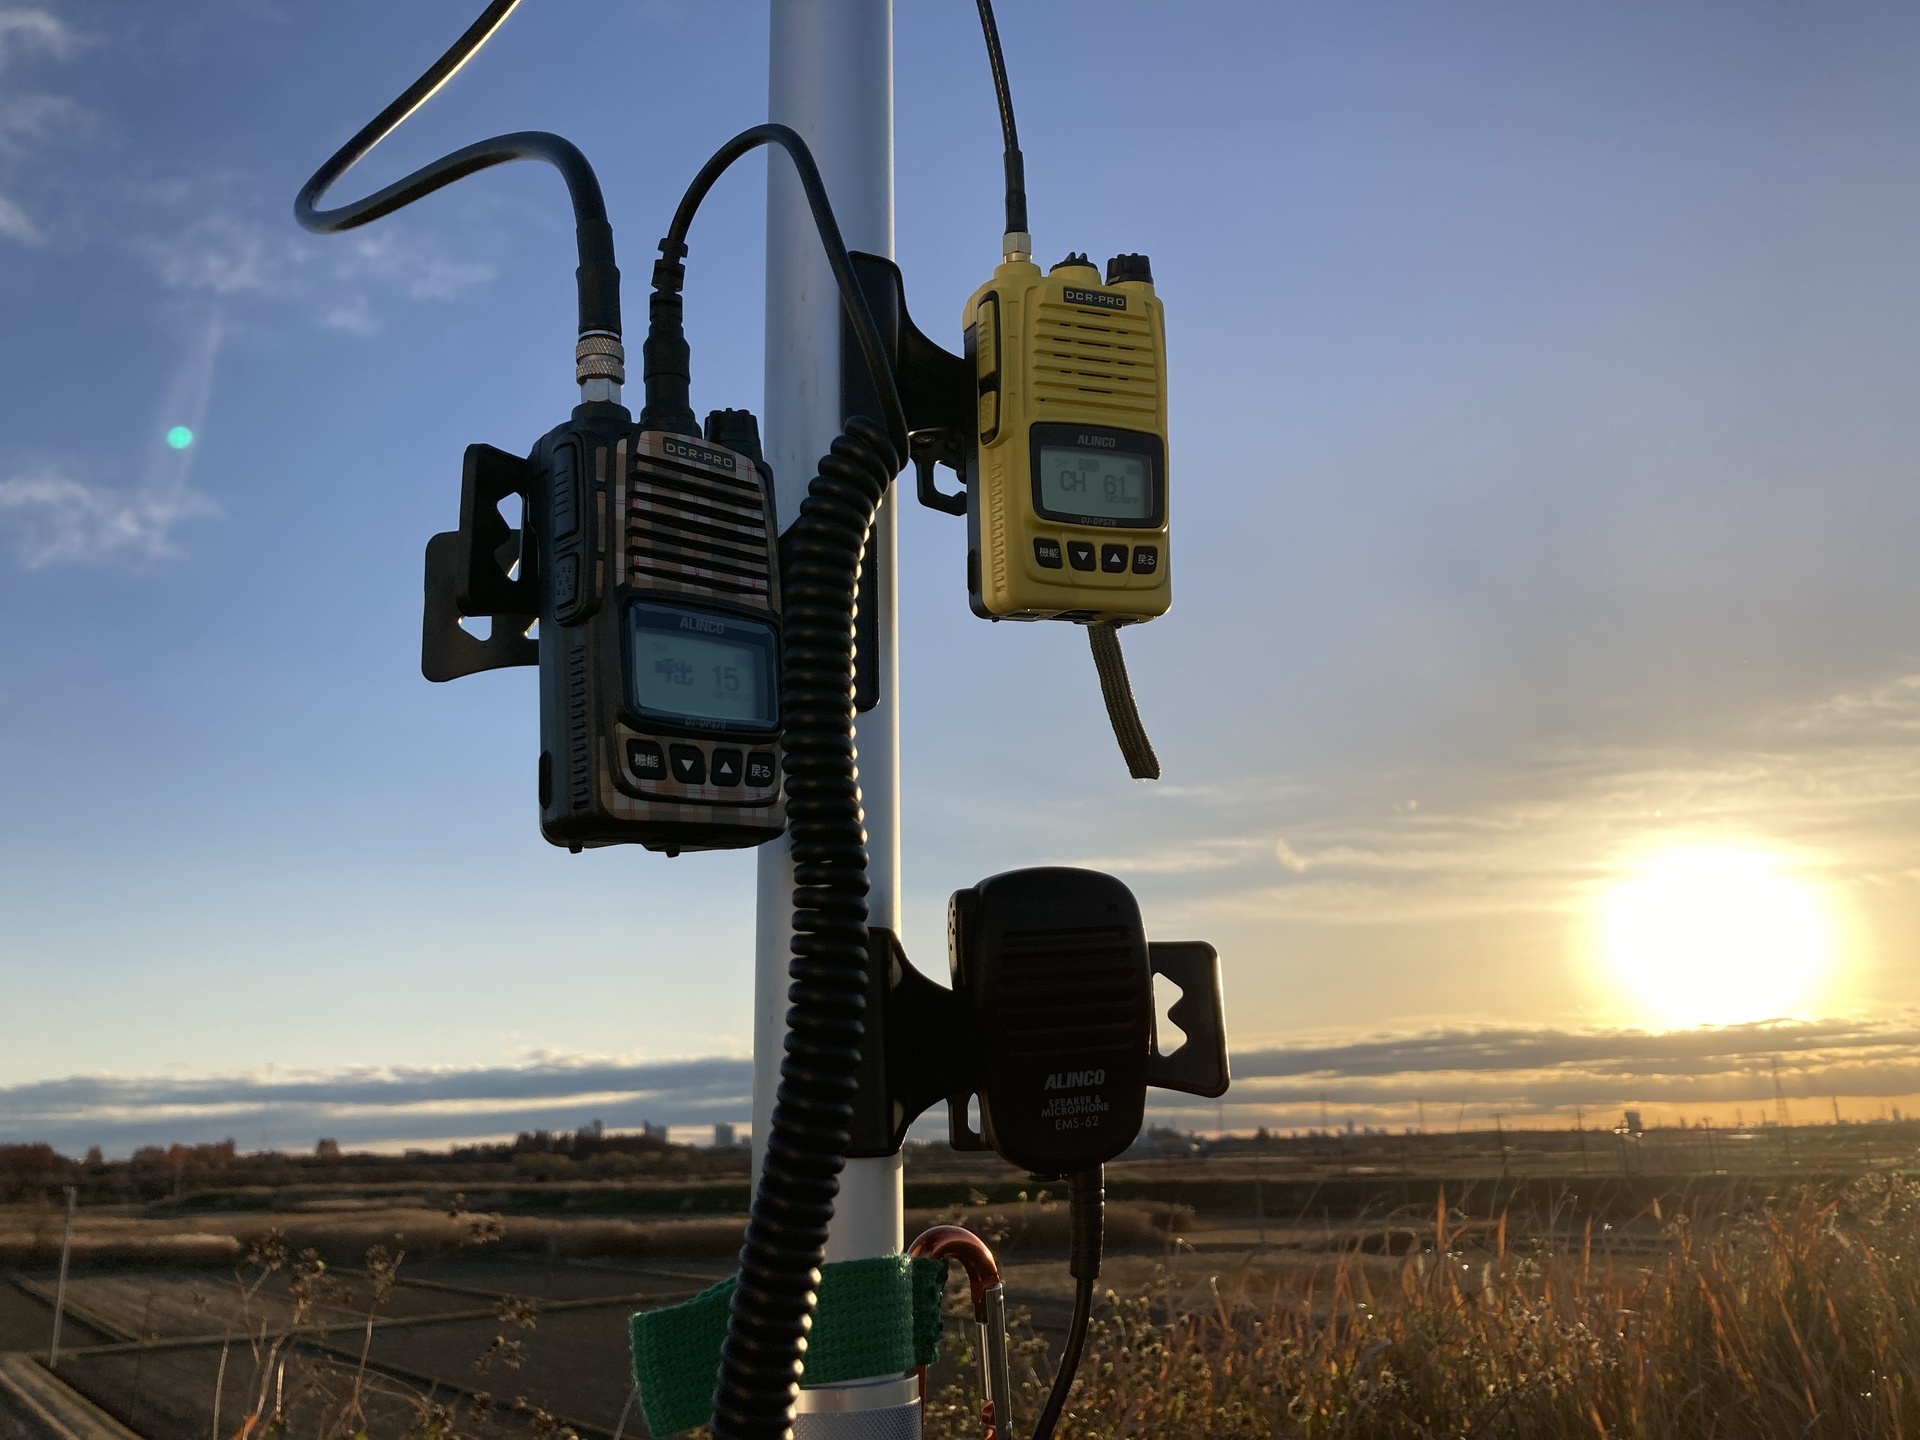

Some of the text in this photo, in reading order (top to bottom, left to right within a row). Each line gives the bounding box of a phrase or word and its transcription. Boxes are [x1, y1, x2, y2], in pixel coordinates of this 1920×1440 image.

[1066, 290, 1125, 307] DCR-PRO
[1077, 434, 1116, 448] ALINCO
[665, 442, 733, 468] DCR-PRO
[1059, 470, 1126, 496] CH 61
[1039, 546, 1059, 559] 機能
[1137, 554, 1155, 566] 戻る
[679, 616, 725, 635] ALINCO
[712, 664, 741, 693] 15
[634, 752, 659, 769] 機能
[751, 763, 771, 778] 戻る
[1044, 1069, 1106, 1091] ALINCO
[1041, 1102, 1110, 1118] MICROPHONE
[1048, 1095, 1092, 1109] SPEAKER
[1055, 1115, 1099, 1131] EMS-62
